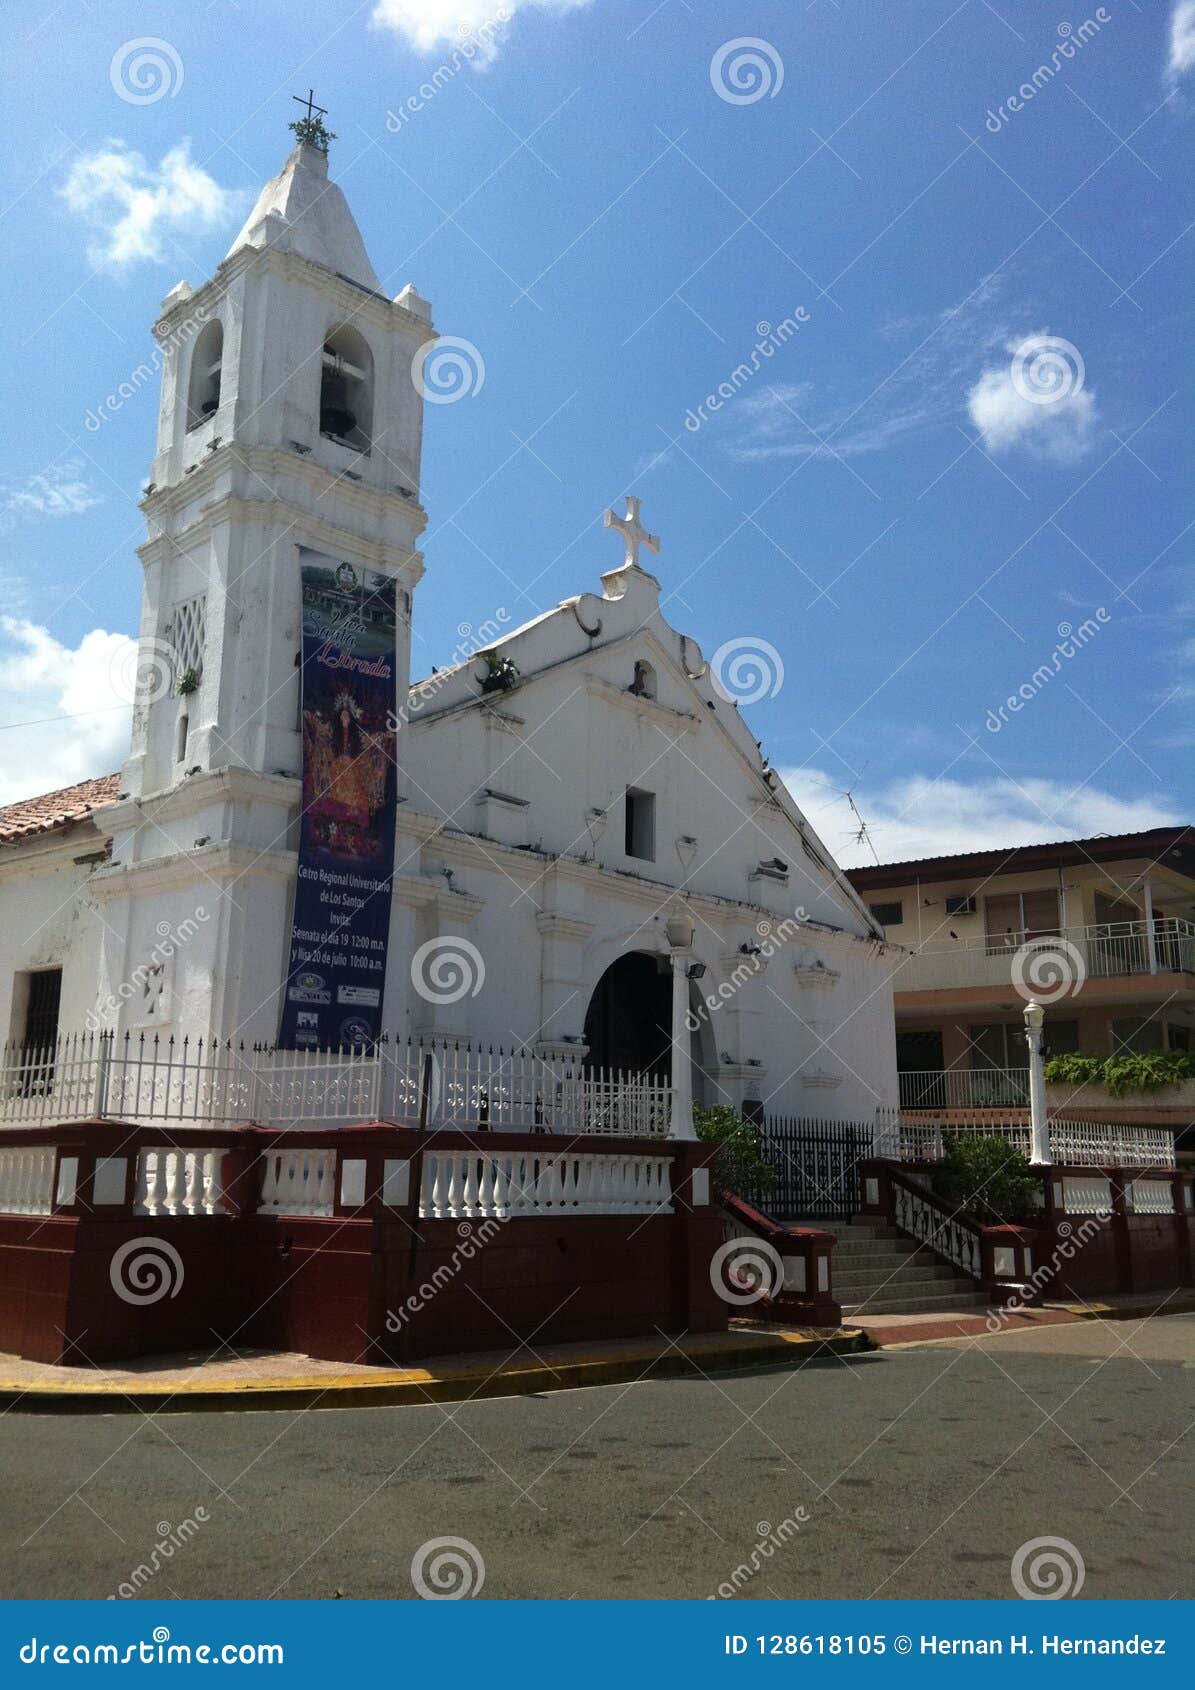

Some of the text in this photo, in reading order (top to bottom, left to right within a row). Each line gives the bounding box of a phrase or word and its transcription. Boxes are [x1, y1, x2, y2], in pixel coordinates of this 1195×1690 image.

[303, 612, 357, 648] Santa
[317, 640, 391, 679] Librada
[298, 865, 391, 892] Cetro Regional Universitario
[320, 890, 365, 908] de Los Santos
[341, 934, 349, 946] 19
[292, 949, 297, 961] y
[312, 950, 321, 963] 20
[322, 951, 331, 964] de
[350, 955, 368, 968] 10:00
